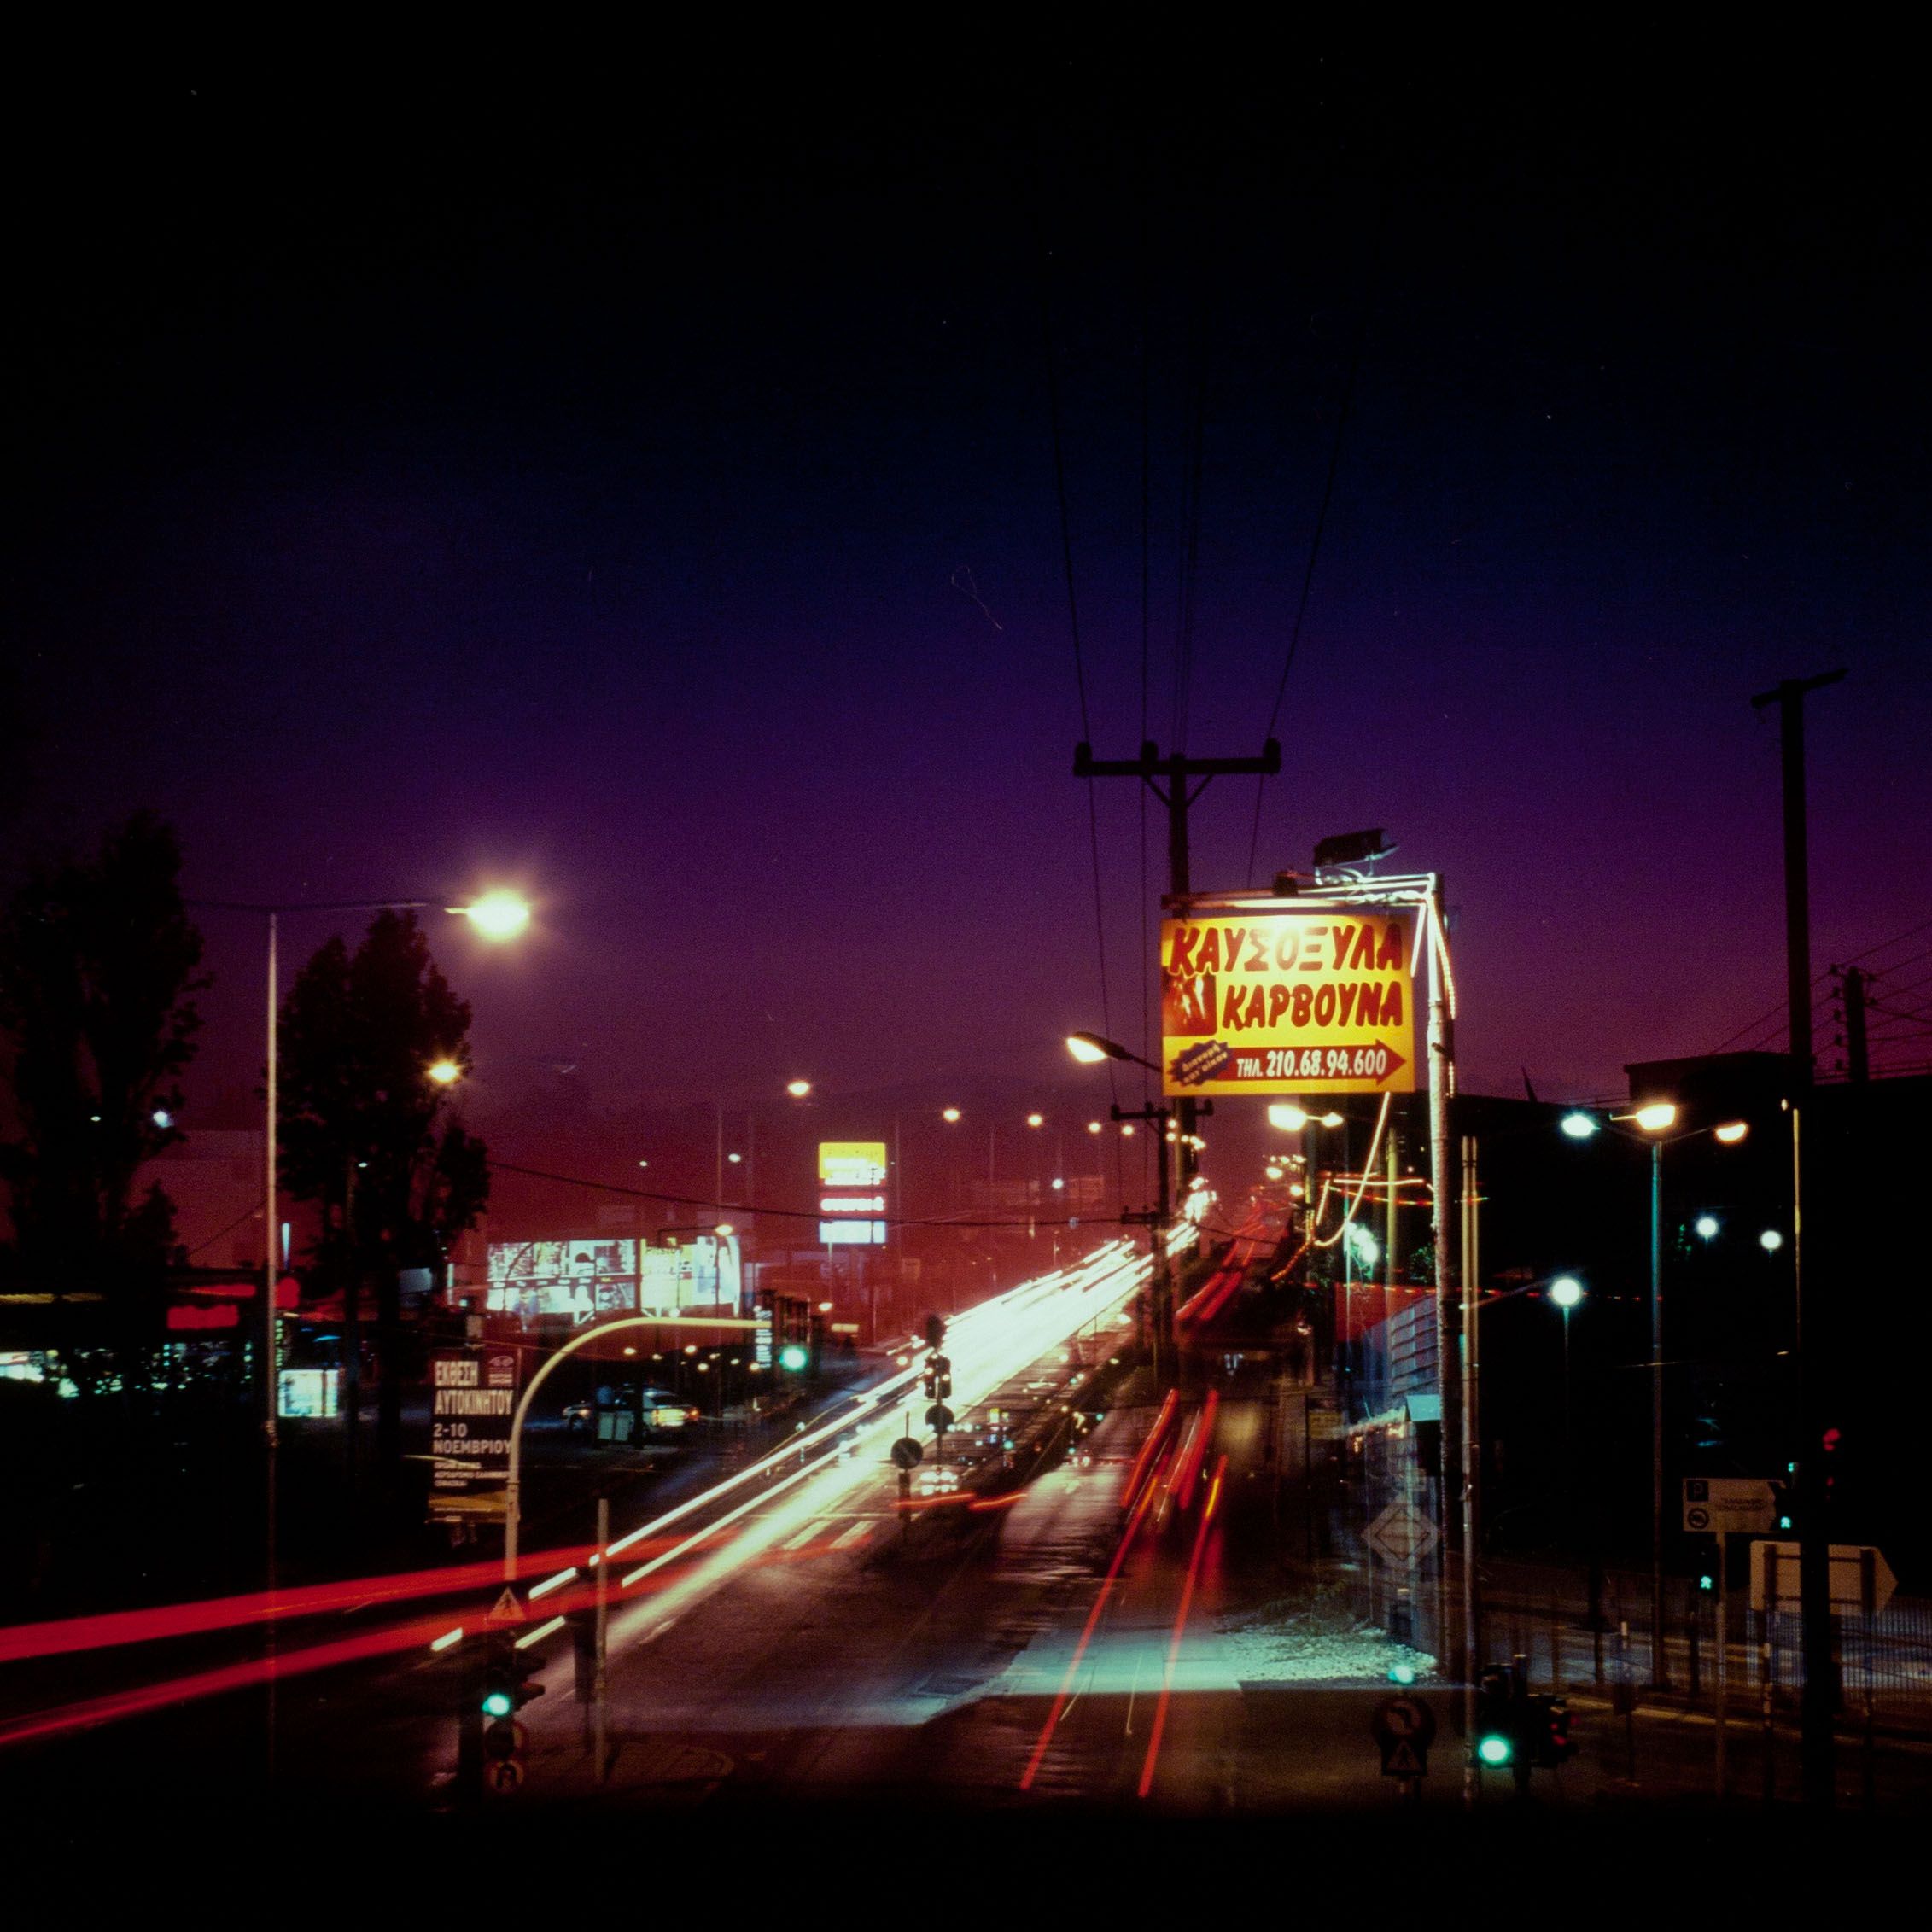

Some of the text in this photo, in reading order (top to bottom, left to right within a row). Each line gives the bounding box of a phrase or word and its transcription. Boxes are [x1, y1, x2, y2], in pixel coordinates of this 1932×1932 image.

[1169, 923, 1403, 975] ΚΑΥΣΟΞΥΛΑ
[1222, 981, 1403, 1030] ΚΑΡΒΟΥΝΑ
[1266, 1049, 1387, 1077] 210.68.94.600
[435, 1361, 478, 1386] ΕΚΘΕΣΗ
[435, 1389, 513, 1415] ΑΥΤΟΚΙΝΗΤΟΥ
[434, 1423, 467, 1438] 2-10
[434, 1439, 511, 1454] ΝΟΕΜΒΡΙΟΥ
